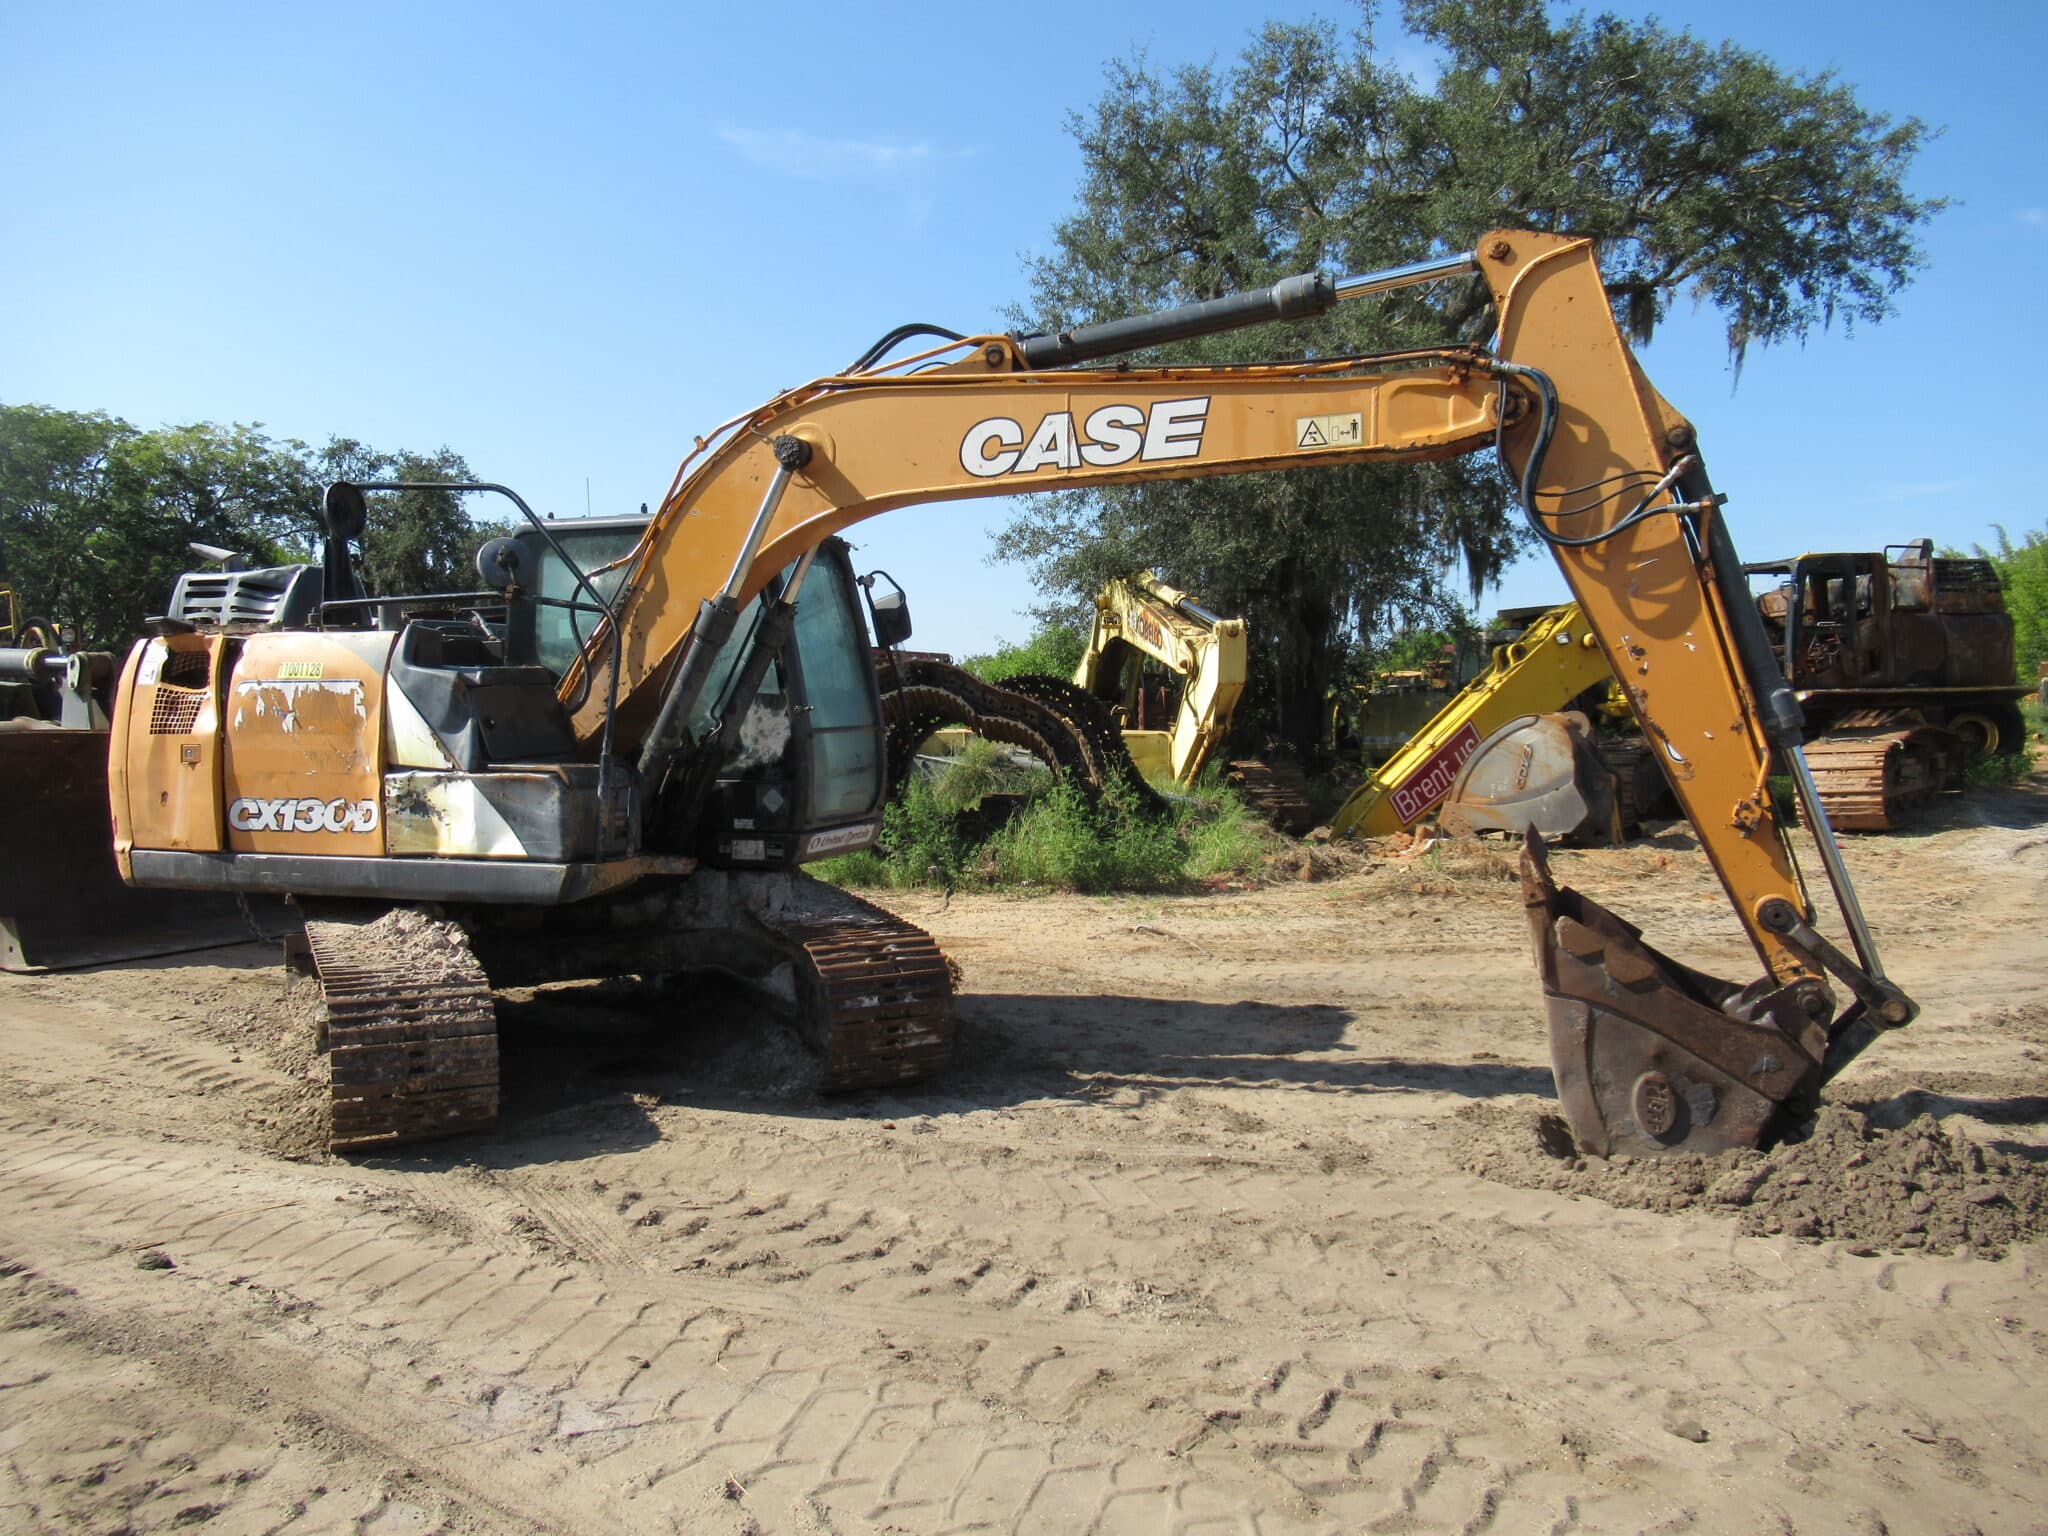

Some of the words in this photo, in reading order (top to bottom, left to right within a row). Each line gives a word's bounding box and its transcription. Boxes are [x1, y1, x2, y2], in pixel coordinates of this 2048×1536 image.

[960, 396, 1211, 477] CASE
[229, 797, 379, 832] CX130D
[1396, 758, 1455, 817] Brent
